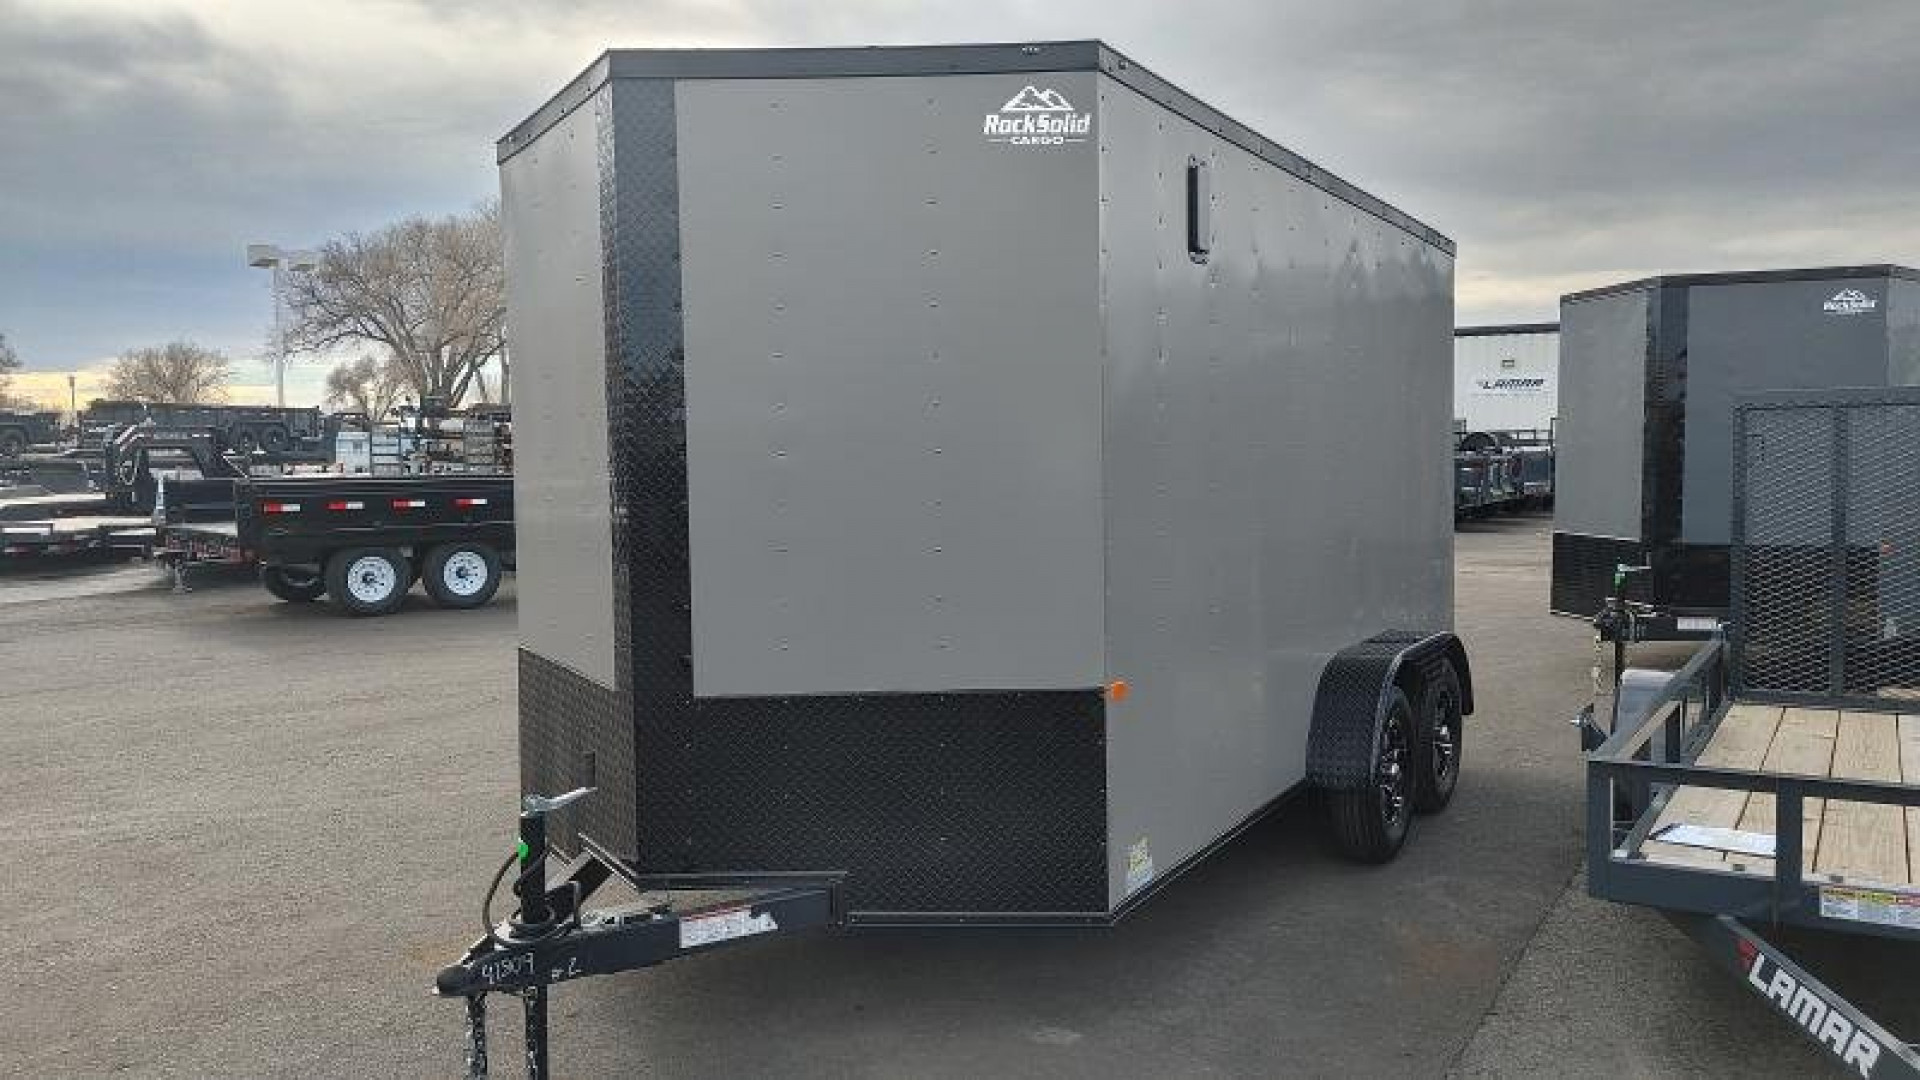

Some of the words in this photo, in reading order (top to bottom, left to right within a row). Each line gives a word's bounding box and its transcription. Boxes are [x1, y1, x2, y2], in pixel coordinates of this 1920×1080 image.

[984, 113, 1091, 134] RockSolid
[1011, 136, 1064, 144] CARGO
[1749, 952, 1880, 1079] LAMAR
